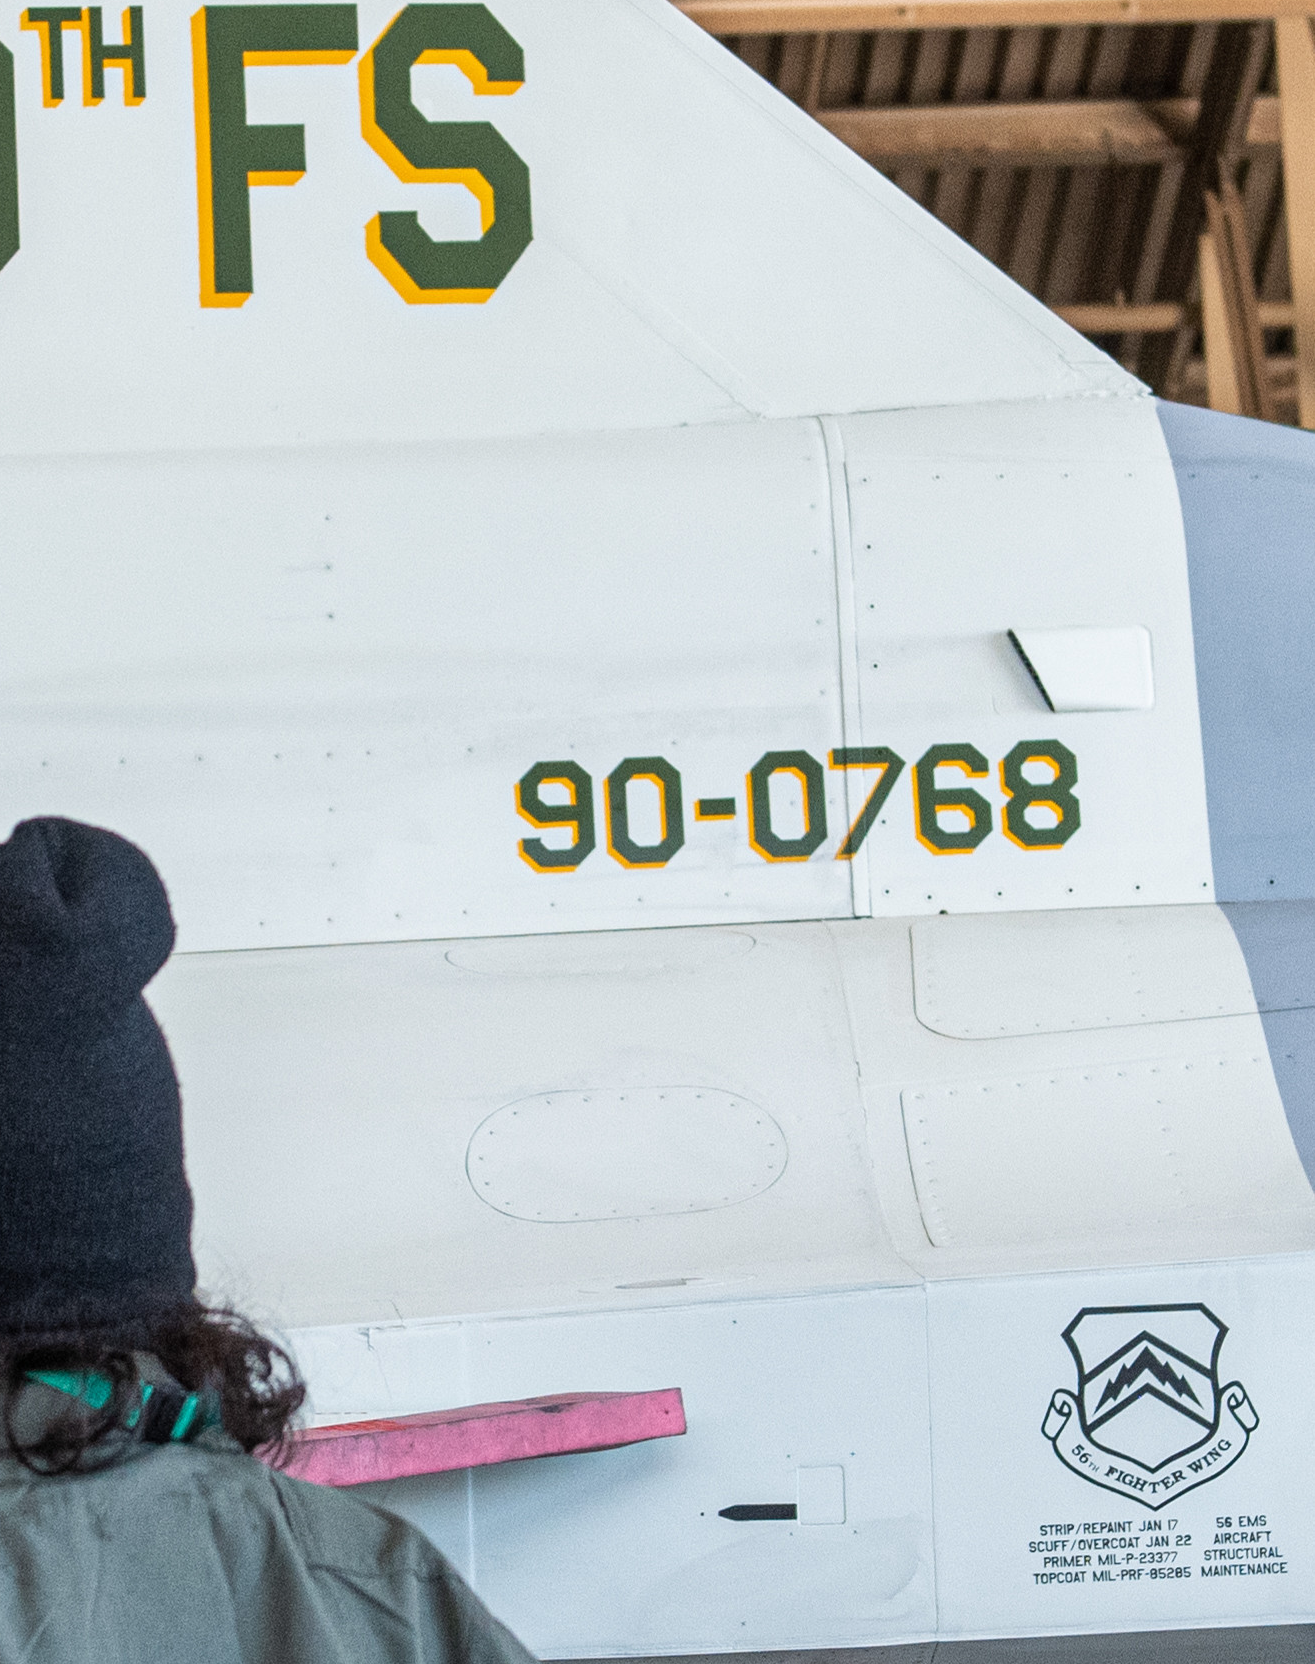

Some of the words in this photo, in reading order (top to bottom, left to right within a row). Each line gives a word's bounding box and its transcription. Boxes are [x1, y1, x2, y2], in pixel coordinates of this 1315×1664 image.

[189, 3, 533, 309] FS
[514, 738, 1082, 874] 90-0768
[1104, 1465, 1187, 1494] FIGHTER
[1187, 1438, 1233, 1474] WING
[1039, 1520, 1133, 1536] STRIP/REPAINT
[1138, 1520, 1162, 1532] JAN
[1168, 1519, 1179, 1531] 17
[1216, 1516, 1232, 1528] 56
[1238, 1515, 1267, 1528] EMS
[1029, 1536, 1140, 1552] SCUFF/OVERCOAT
[1146, 1536, 1169, 1548] JAN
[1175, 1535, 1192, 1546] 22
[1213, 1531, 1272, 1545] AIRCRAFT
[1043, 1555, 1091, 1568] PRIMER
[1098, 1551, 1178, 1566] MIL-P-23377
[1203, 1547, 1283, 1562] STRUCTURAL
[1033, 1571, 1086, 1585] TOPCOAT
[1092, 1567, 1192, 1583] MIL-PRF-85285
[1201, 1562, 1288, 1578] MAINTENANCE
